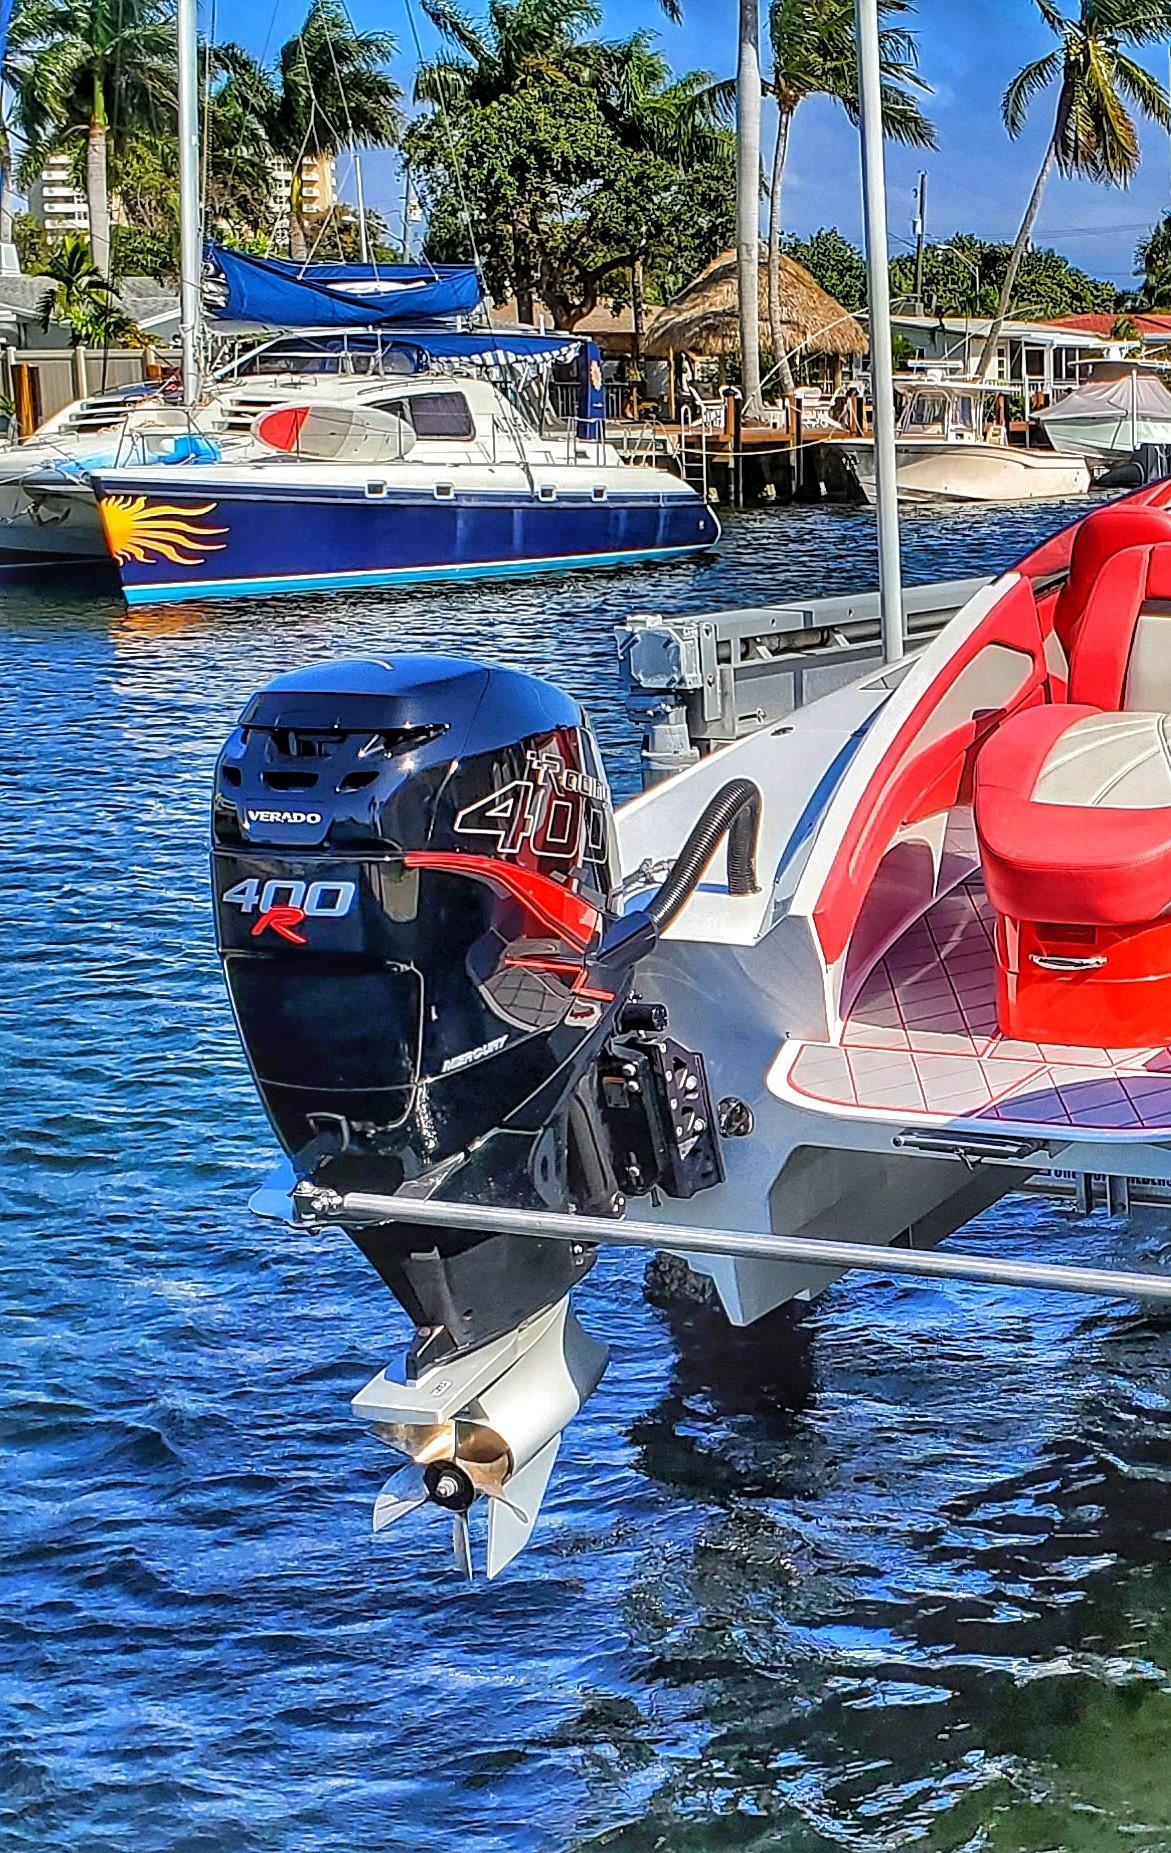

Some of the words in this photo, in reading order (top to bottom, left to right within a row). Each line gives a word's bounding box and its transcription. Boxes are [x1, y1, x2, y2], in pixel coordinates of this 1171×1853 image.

[247, 810, 321, 824] VERADO
[454, 780, 609, 864] 400
[222, 879, 355, 917] 400
[251, 905, 306, 943] R
[441, 1033, 509, 1073] MERCURY
